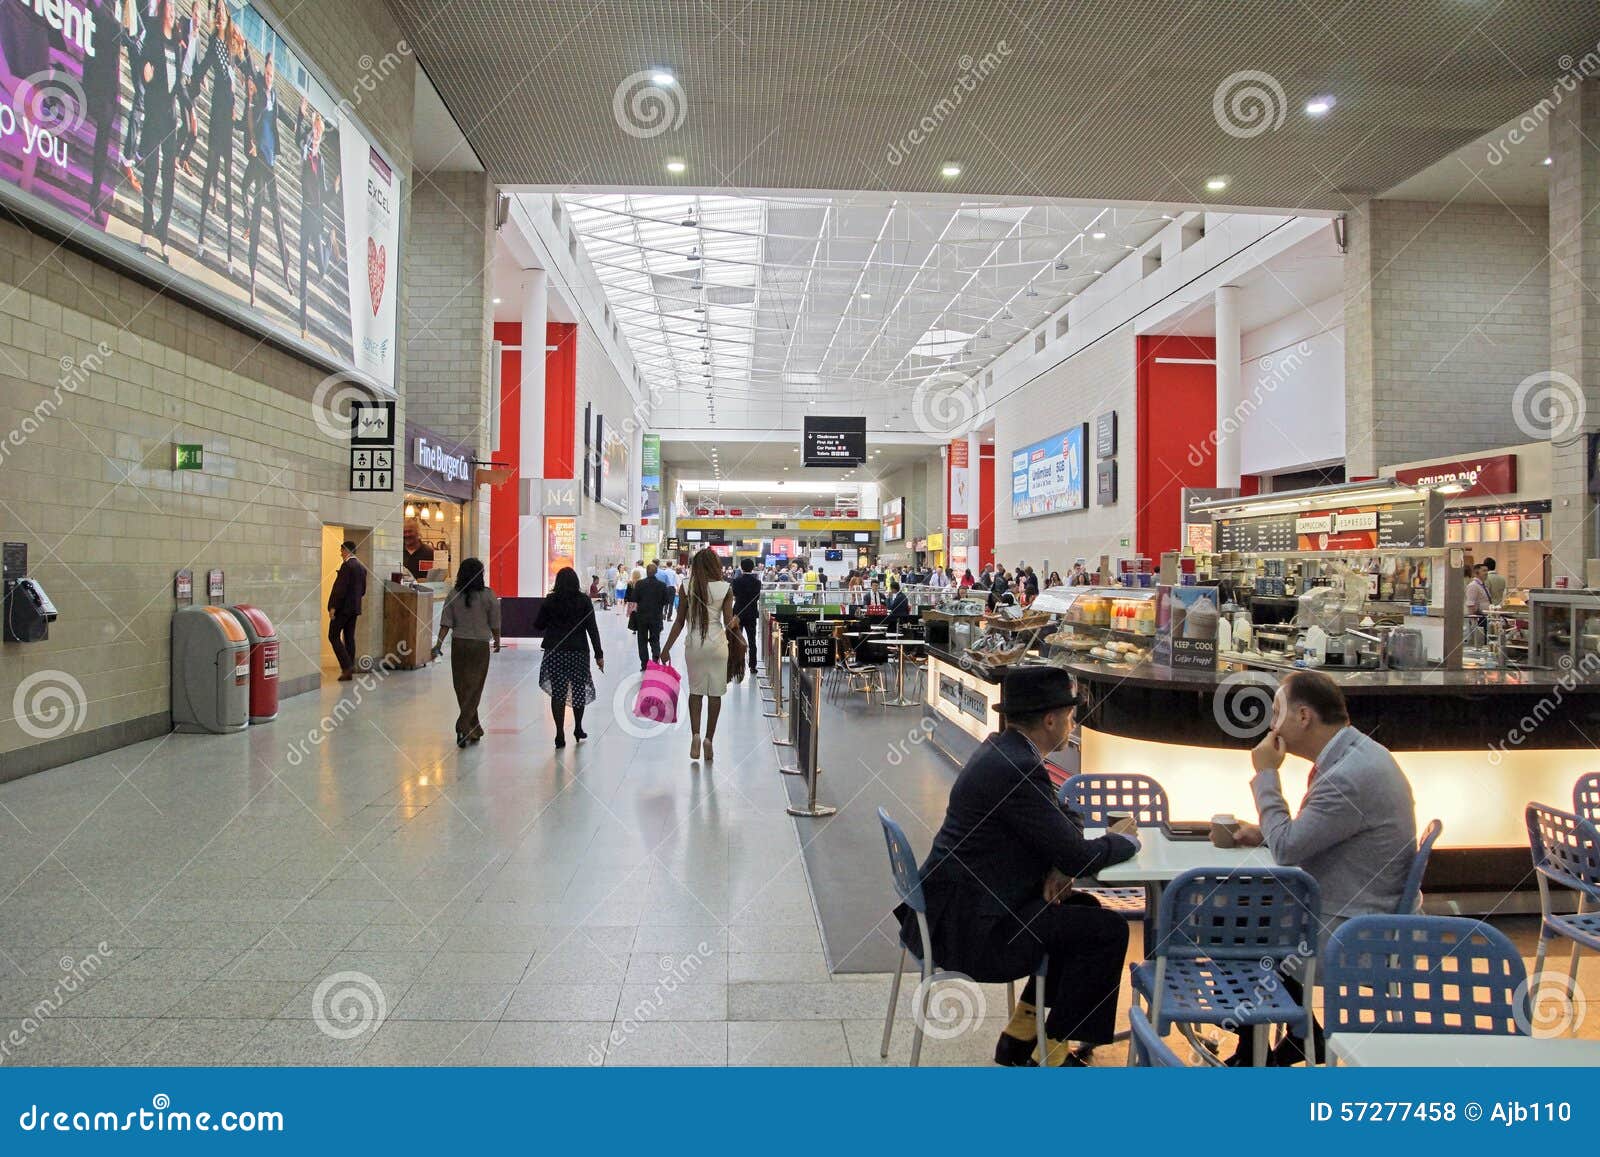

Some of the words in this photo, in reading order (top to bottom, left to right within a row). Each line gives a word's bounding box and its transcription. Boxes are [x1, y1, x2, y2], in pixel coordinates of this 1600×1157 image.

[23, 116, 68, 168] you
[419, 438, 436, 470] Fine
[436, 445, 460, 482] Burger
[548, 488, 576, 506] N4
[1340, 517, 1373, 528] ESPRESSO
[953, 533, 966, 542] S5
[1173, 640, 1190, 649] KEEP
[1194, 642, 1214, 650] COOL
